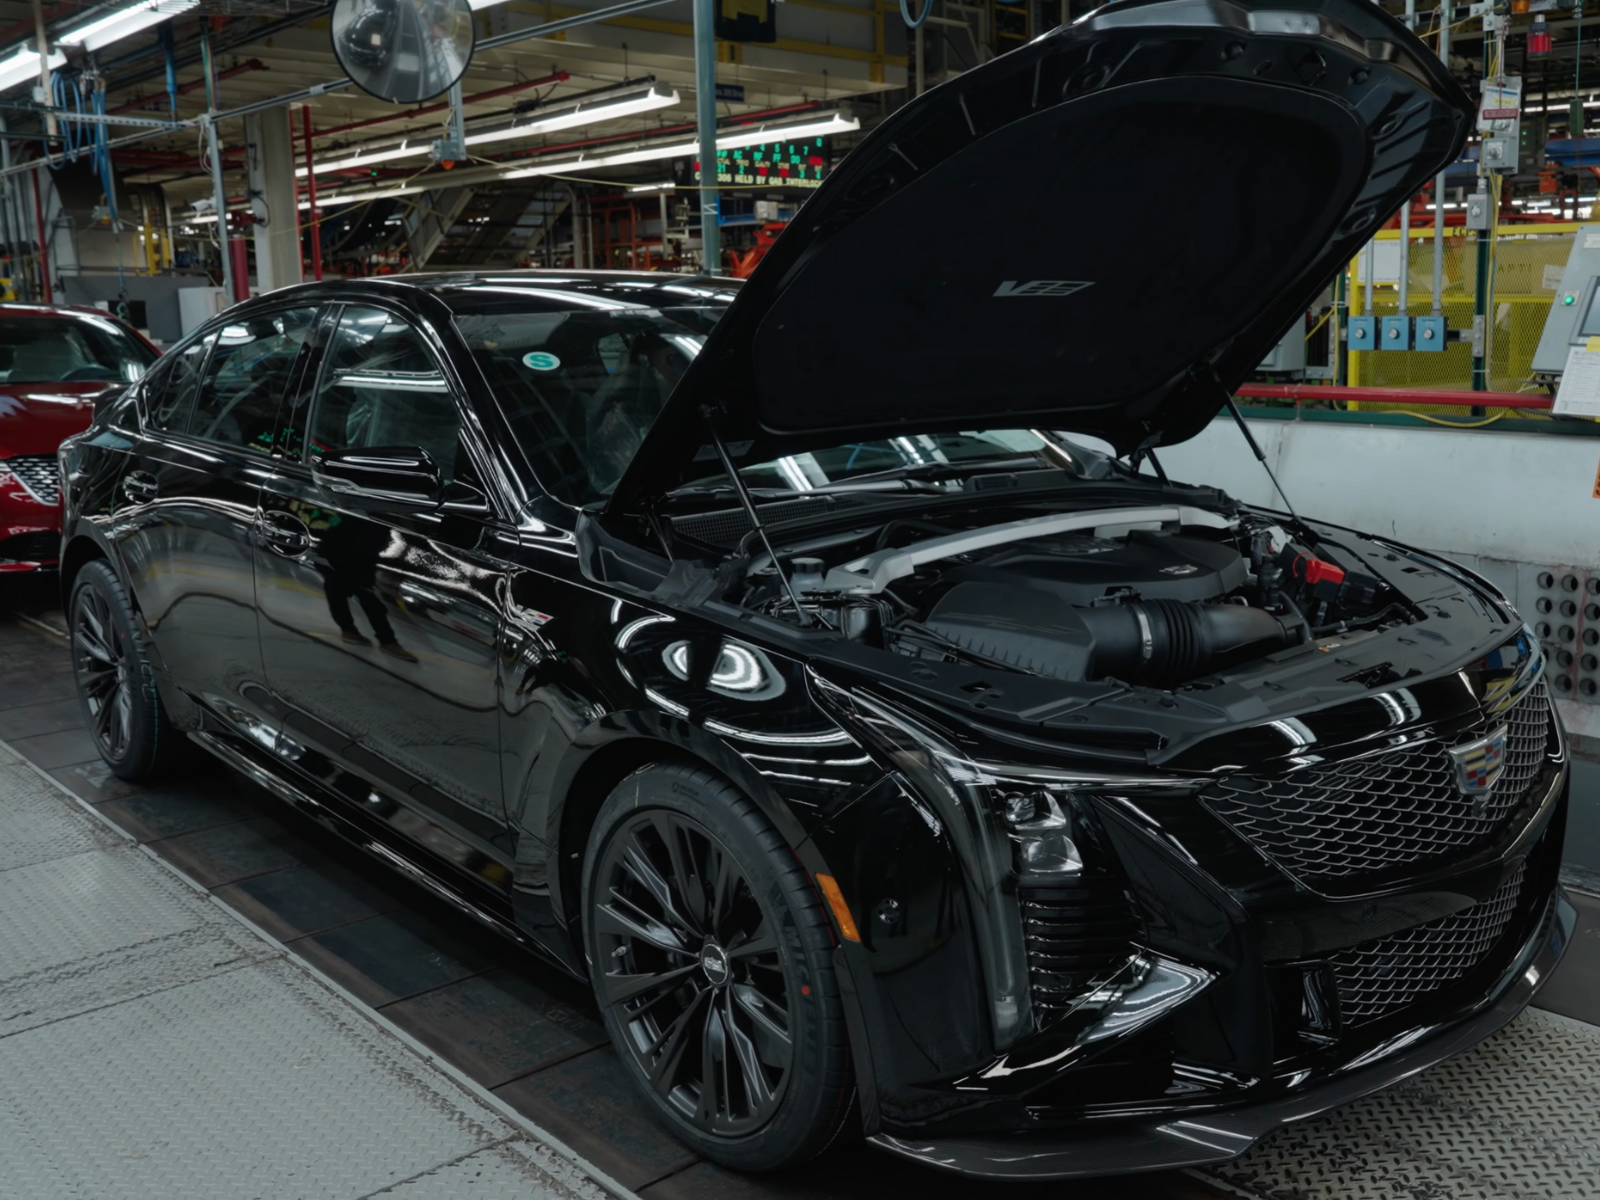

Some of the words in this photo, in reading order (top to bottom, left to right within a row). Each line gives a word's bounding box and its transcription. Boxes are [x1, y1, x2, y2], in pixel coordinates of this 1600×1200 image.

[735, 175, 753, 184] HELD
[756, 176, 765, 185] BY
[529, 354, 554, 369] S
[783, 925, 818, 1076] MICELIN
